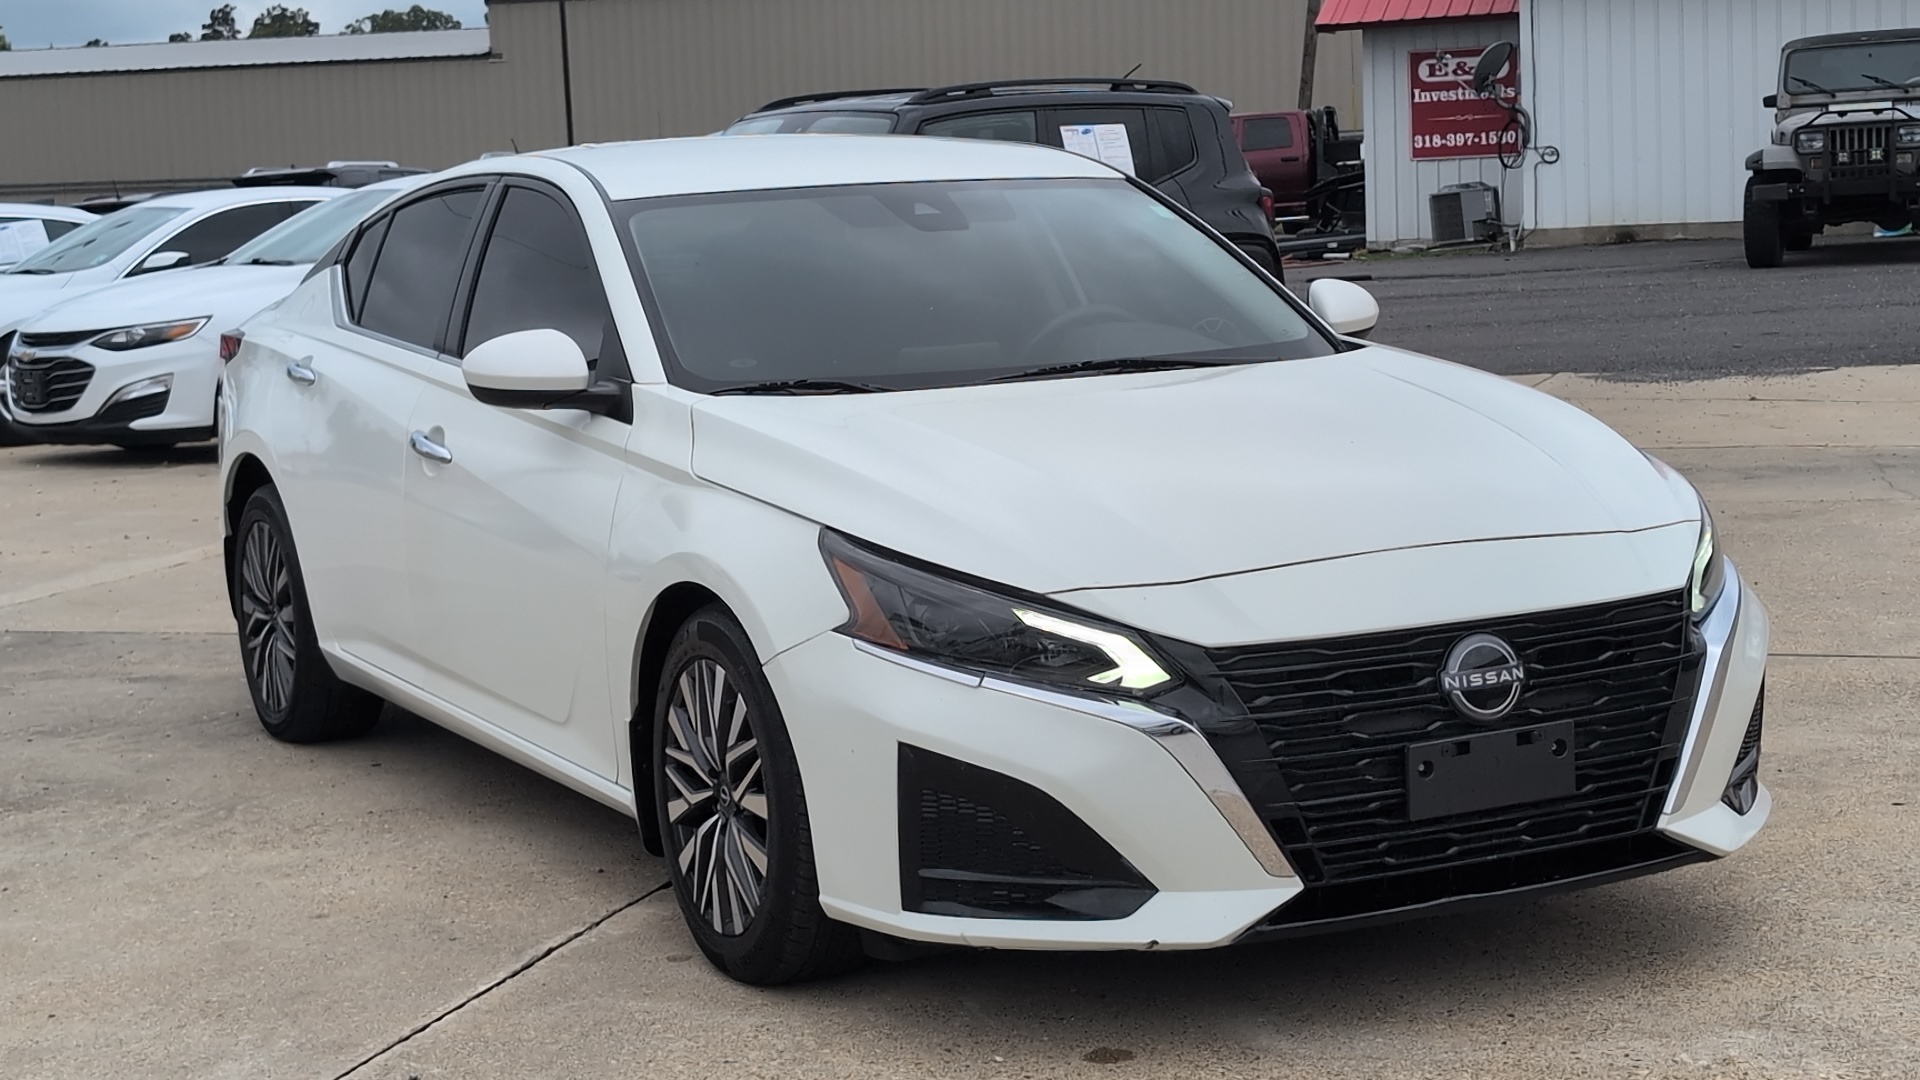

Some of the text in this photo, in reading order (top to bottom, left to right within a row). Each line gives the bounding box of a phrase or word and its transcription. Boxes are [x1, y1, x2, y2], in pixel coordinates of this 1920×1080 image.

[1425, 61, 1476, 78] E &
[1413, 86, 1516, 103] Investmets
[1444, 666, 1524, 689] NISSAN
